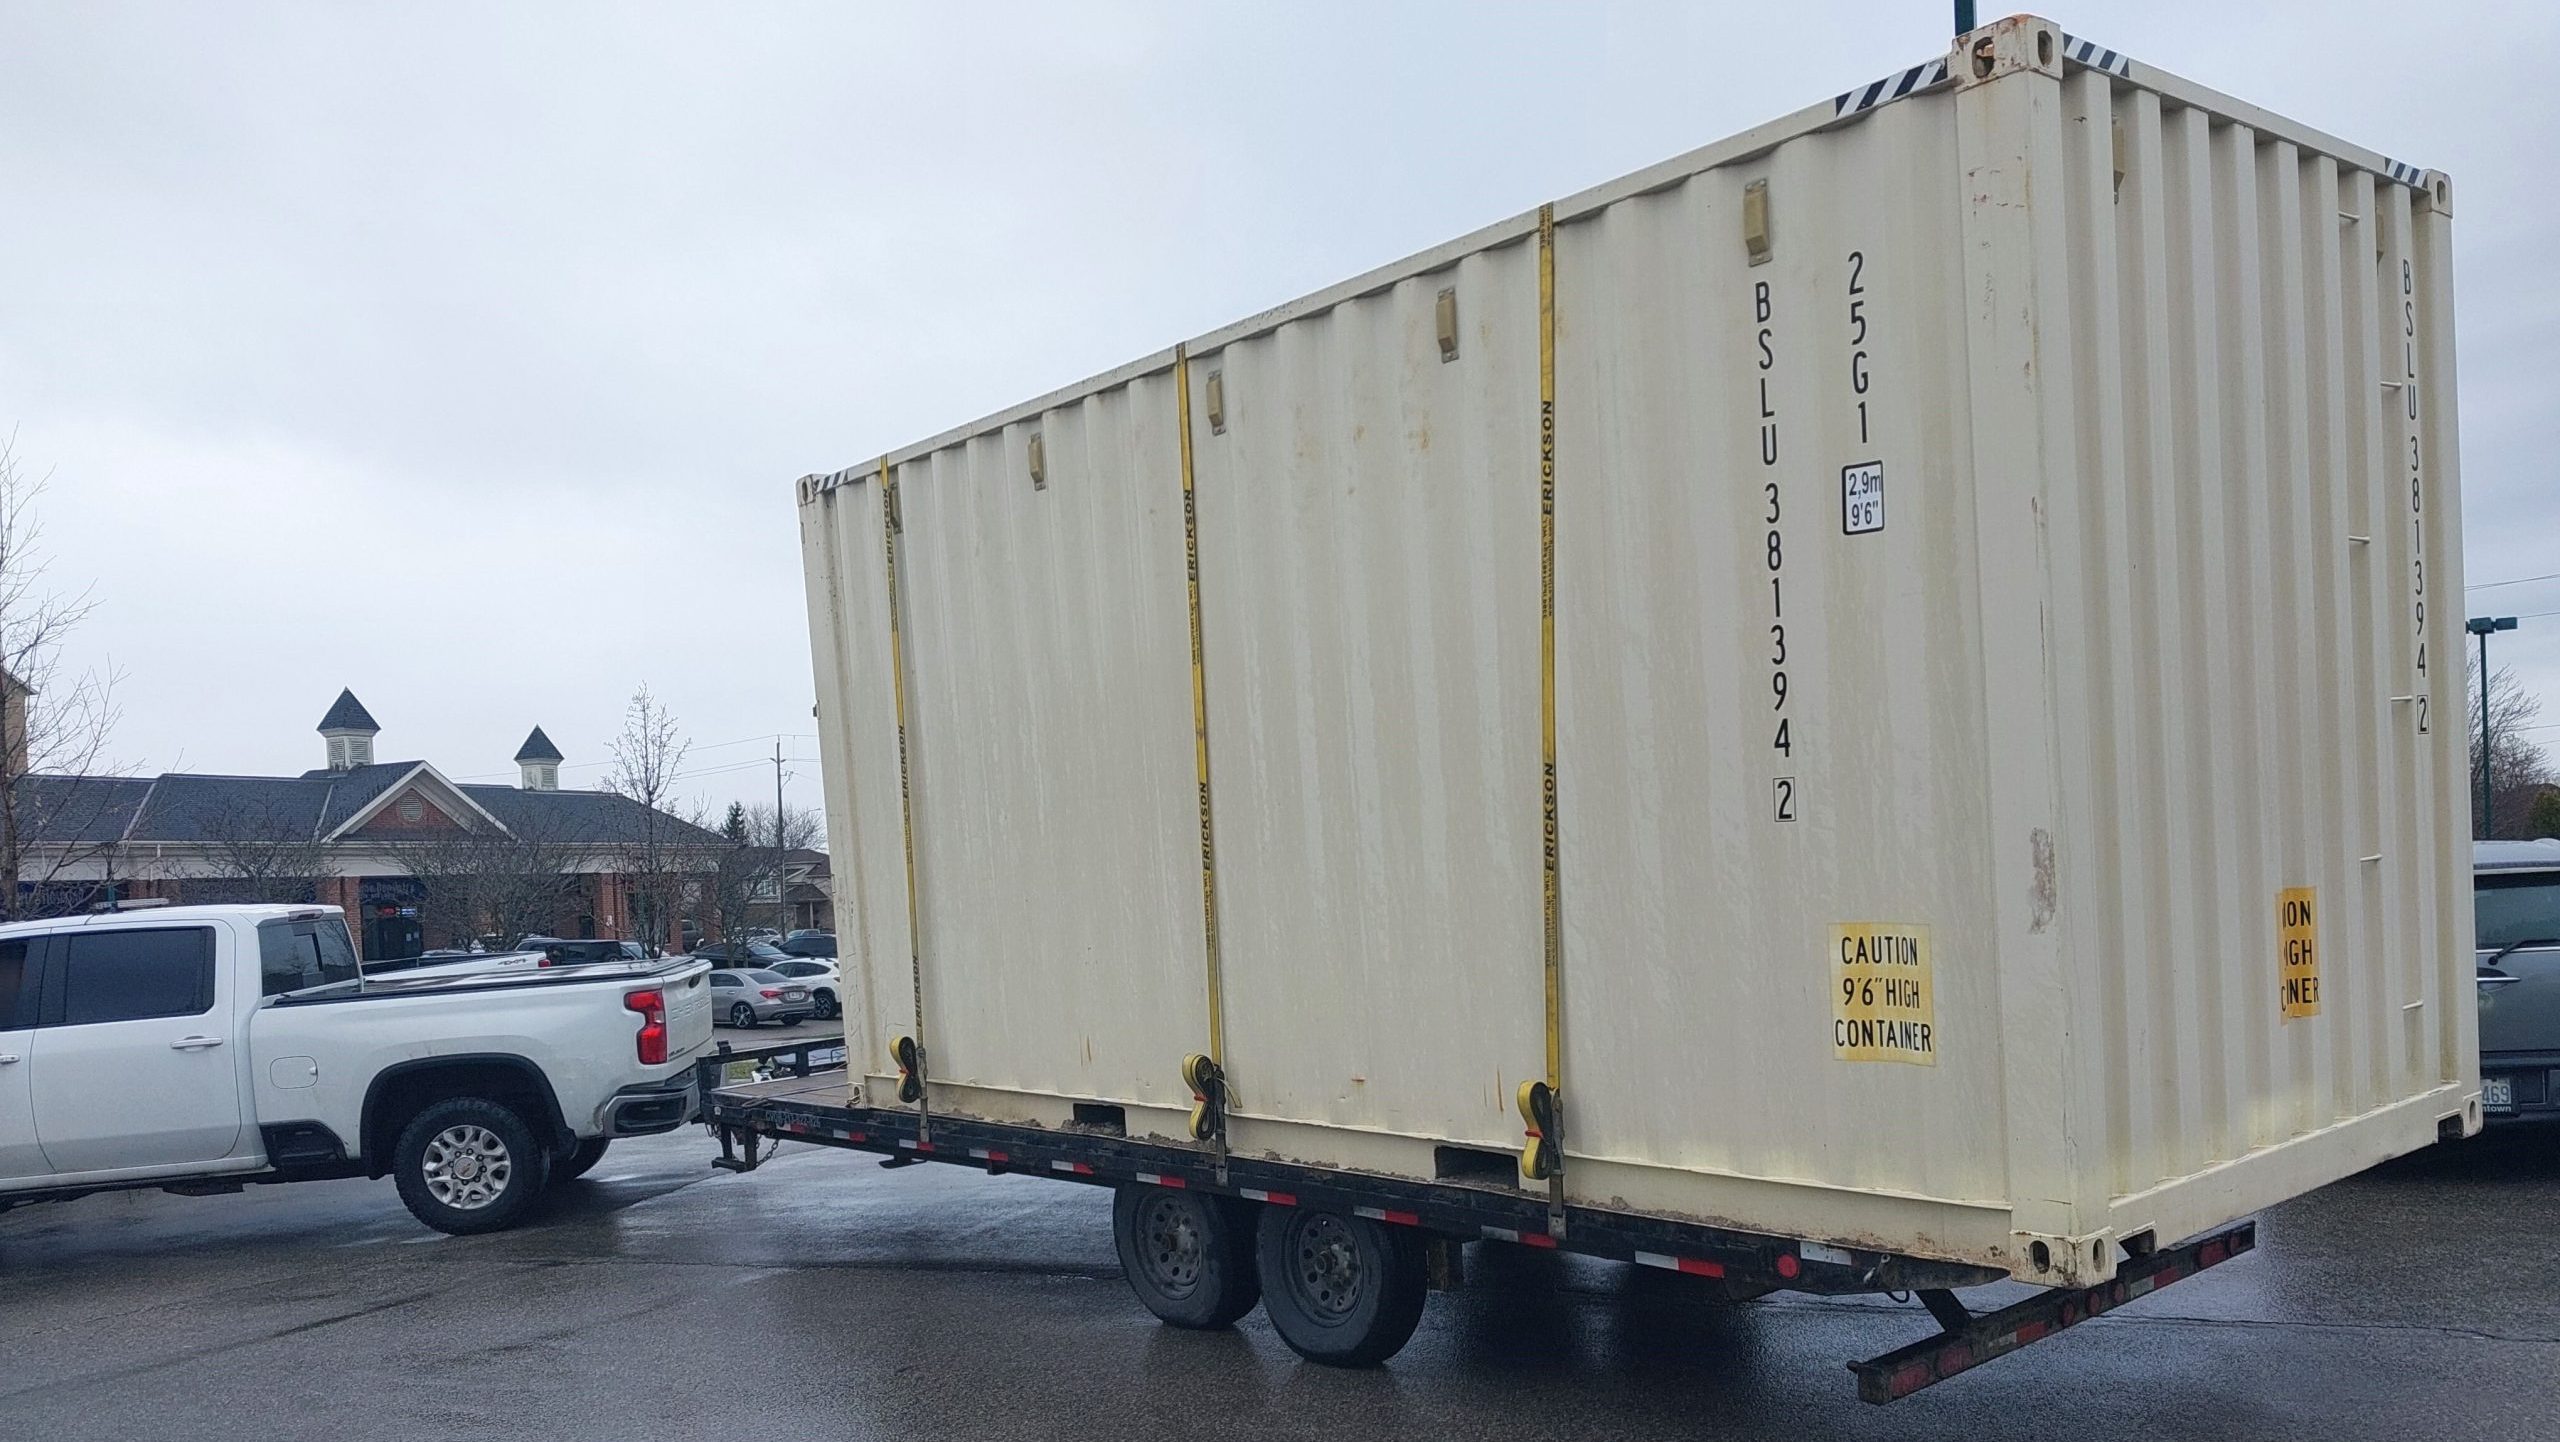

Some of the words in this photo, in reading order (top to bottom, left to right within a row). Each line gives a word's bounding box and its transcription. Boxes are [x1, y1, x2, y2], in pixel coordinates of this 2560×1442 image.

[1755, 281, 1778, 465] BSLU
[1848, 251, 1869, 444] 25G1
[1542, 401, 1553, 516] ERICKSON
[2403, 259, 2417, 420] BSLU
[2410, 435, 2426, 678] 381394
[2418, 698, 2428, 733] 2
[1184, 490, 1196, 581] ERICKSON
[1851, 500, 1879, 527] 9'6"
[1765, 483, 1790, 757] 381394
[899, 725, 908, 798] ERICKSON
[1777, 780, 1792, 819] 2
[1200, 783, 1211, 871] ERICKSON
[1544, 763, 1555, 872] ERICKSON
[1841, 936, 1918, 966] CAUTION
[1885, 978, 1920, 1008] HIGH
[1835, 1019, 1932, 1052] CONTAINER
